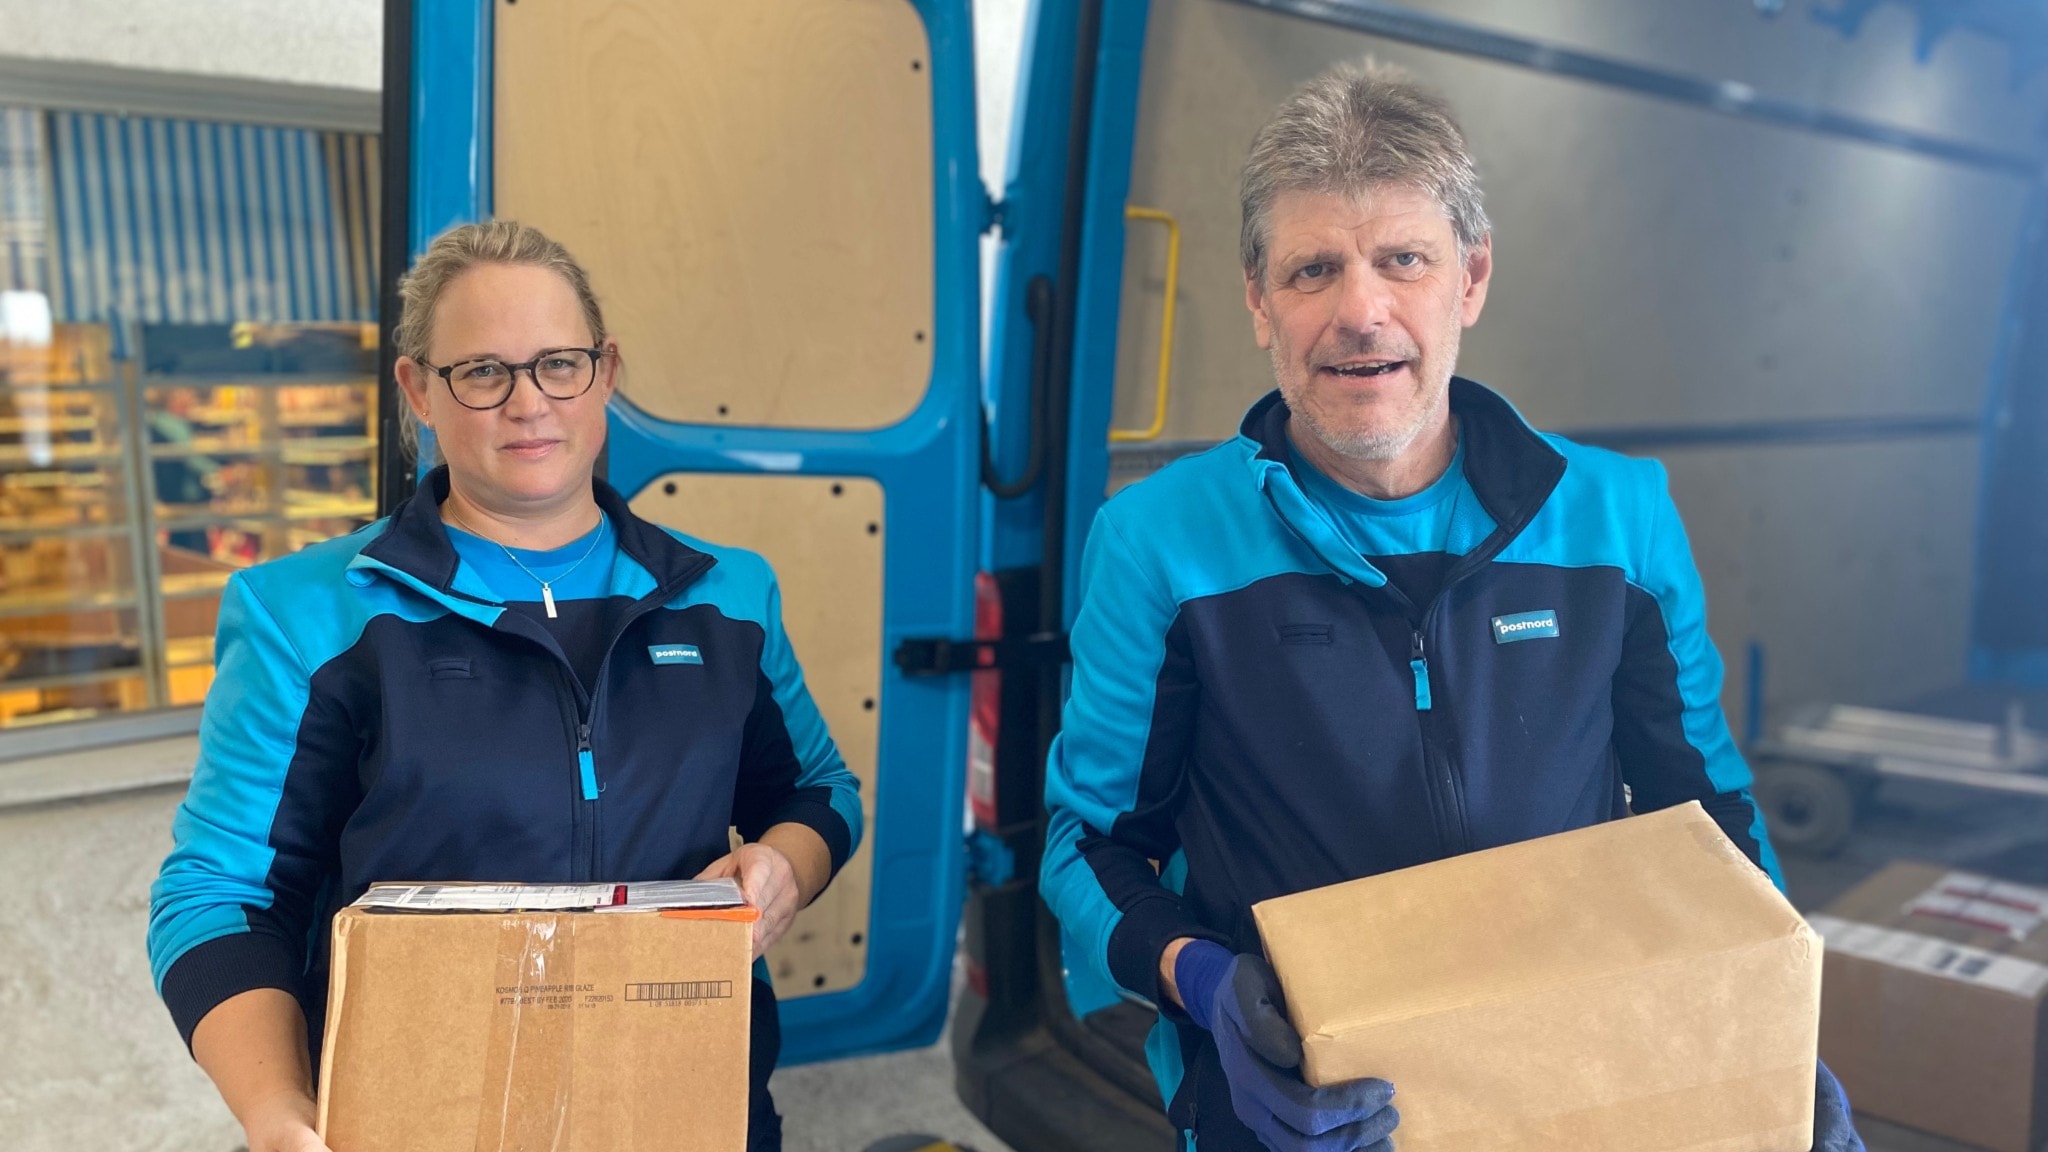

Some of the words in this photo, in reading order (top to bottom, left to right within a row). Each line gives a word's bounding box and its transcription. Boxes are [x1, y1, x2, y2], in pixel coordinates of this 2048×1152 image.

[1500, 618, 1554, 634] postnord
[655, 650, 698, 658] postnord
[530, 985, 562, 993] PINEAPPLE
[575, 984, 595, 992] GLAZE
[545, 996, 557, 1004] FEB
